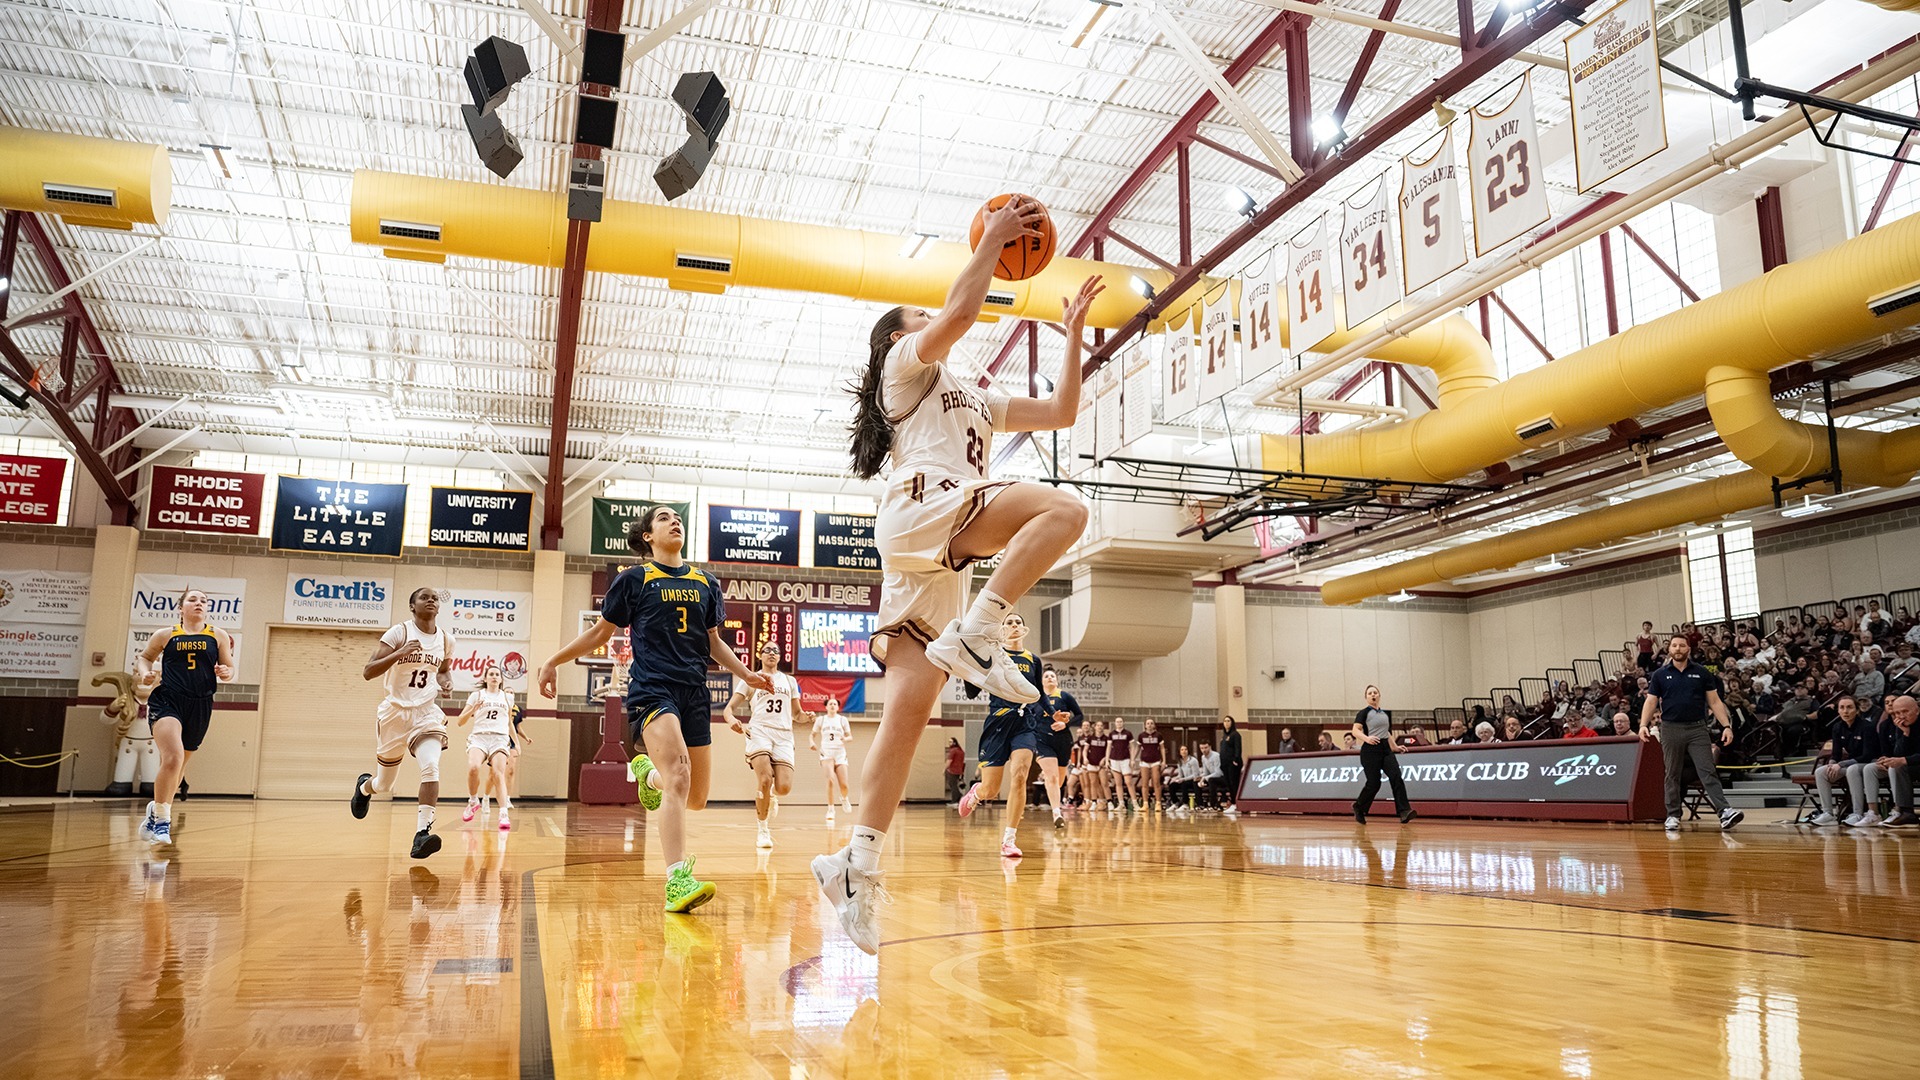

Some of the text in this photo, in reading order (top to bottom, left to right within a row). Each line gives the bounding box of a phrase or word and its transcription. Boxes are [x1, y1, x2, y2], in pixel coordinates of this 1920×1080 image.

[1572, 49, 1604, 75] WOMEN'S
[1606, 20, 1651, 53] BASKETBALL
[1596, 50, 1620, 71] POINT
[1621, 35, 1643, 57] CLUB
[1487, 119, 1519, 150] LANNI
[1485, 139, 1531, 213] 23
[1423, 193, 1440, 248] 5
[1345, 226, 1360, 247] VAN
[1353, 229, 1387, 292] 34
[1299, 269, 1322, 323] 14
[1250, 300, 1271, 351] 14
[1207, 329, 1226, 375] 14
[1171, 354, 1187, 395] 12
[174, 474, 243, 492] RHODE
[169, 492, 244, 510] ISLAND
[316, 486, 369, 505] THE
[447, 494, 517, 510] UNIVERSITY
[0, 500, 49, 516] EGE
[293, 505, 387, 526] LITTLE
[730, 509, 780, 523] WESTERN
[158, 510, 251, 528] COLLEGE
[472, 512, 489, 526] OF
[828, 515, 877, 528] UNIVERSI
[720, 521, 789, 536] CONNECTICUT
[851, 528, 865, 536] OF
[303, 528, 372, 546] EAST
[431, 529, 528, 546] SOUTHERN MAINE
[738, 536, 770, 548] STATE
[725, 548, 782, 561] UNIVERSITY
[852, 548, 865, 556] AT
[837, 556, 878, 568] BOSTON
[294, 578, 385, 602] Cardi's
[661, 589, 700, 602] UMASSD
[724, 580, 871, 606] AND COLLEGE
[134, 591, 242, 614] Navant
[293, 600, 385, 610] FURNITURE MATTRESSES
[453, 599, 516, 610] PEPSICO
[205, 614, 236, 622] NION
[676, 607, 688, 633] 3
[724, 620, 742, 628] UMD
[763, 612, 792, 623] 3 0 0
[801, 612, 864, 632] WELCOME
[0, 629, 79, 643] SingleSource
[452, 627, 515, 637] Foodservice
[771, 623, 778, 633] 0
[785, 624, 792, 633] 0
[735, 630, 746, 646] 0
[759, 632, 792, 643] 12 0 0
[800, 629, 844, 648] RHODE
[176, 641, 207, 651] UMASSD
[785, 643, 792, 653] 0
[187, 653, 196, 670] 5
[741, 654, 749, 667] 0
[785, 653, 792, 662] 0
[408, 670, 428, 688] 13
[1079, 664, 1111, 681] Grindz
[1079, 680, 1102, 691] Shop
[802, 692, 829, 700] Division
[766, 699, 782, 713] 33
[486, 710, 499, 720] 12
[829, 733, 835, 741] 3
[1252, 762, 1616, 783] VALLEY CC VALLEY UNTRY CLUB VALLEY CC
